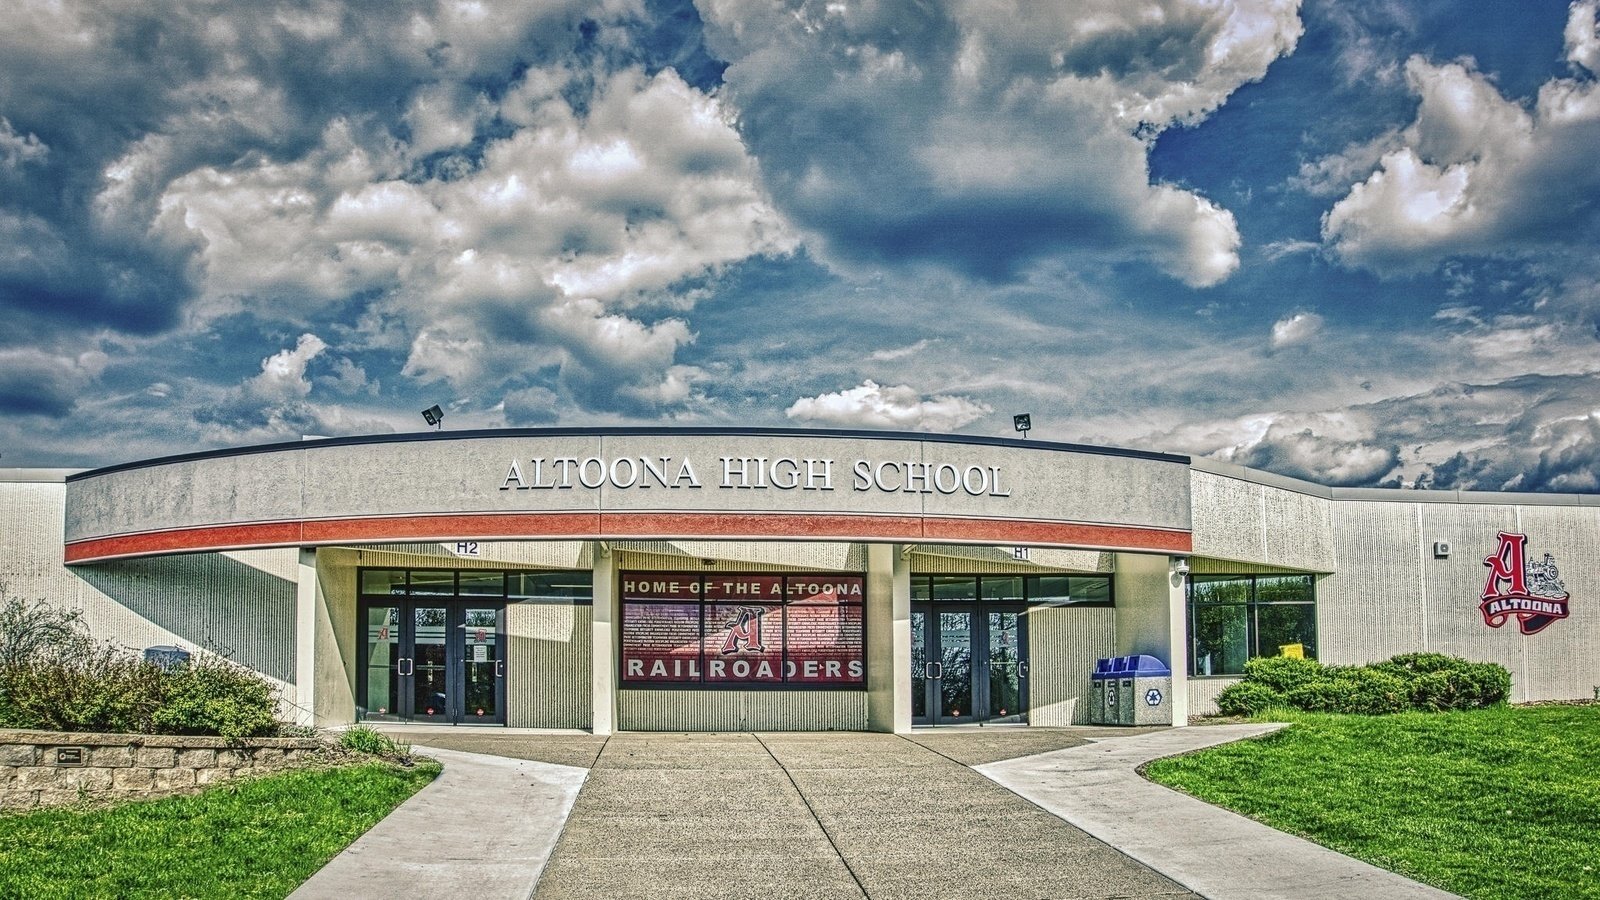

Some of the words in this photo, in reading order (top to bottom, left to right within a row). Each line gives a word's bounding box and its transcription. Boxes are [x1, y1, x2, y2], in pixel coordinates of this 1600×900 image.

[499, 456, 702, 490] ALTOONA
[719, 457, 834, 491] HIGH
[853, 460, 1012, 497] SCHOOL
[457, 541, 478, 554] H2
[1014, 546, 1029, 559] H1
[1482, 531, 1527, 599] A
[623, 581, 680, 593] HOME
[689, 582, 714, 593] OF
[722, 582, 761, 594] THE
[770, 583, 862, 595] ALTOONA
[1490, 598, 1562, 614] ALTOONA
[721, 606, 766, 654] A
[627, 659, 863, 678] RAILROADERS
